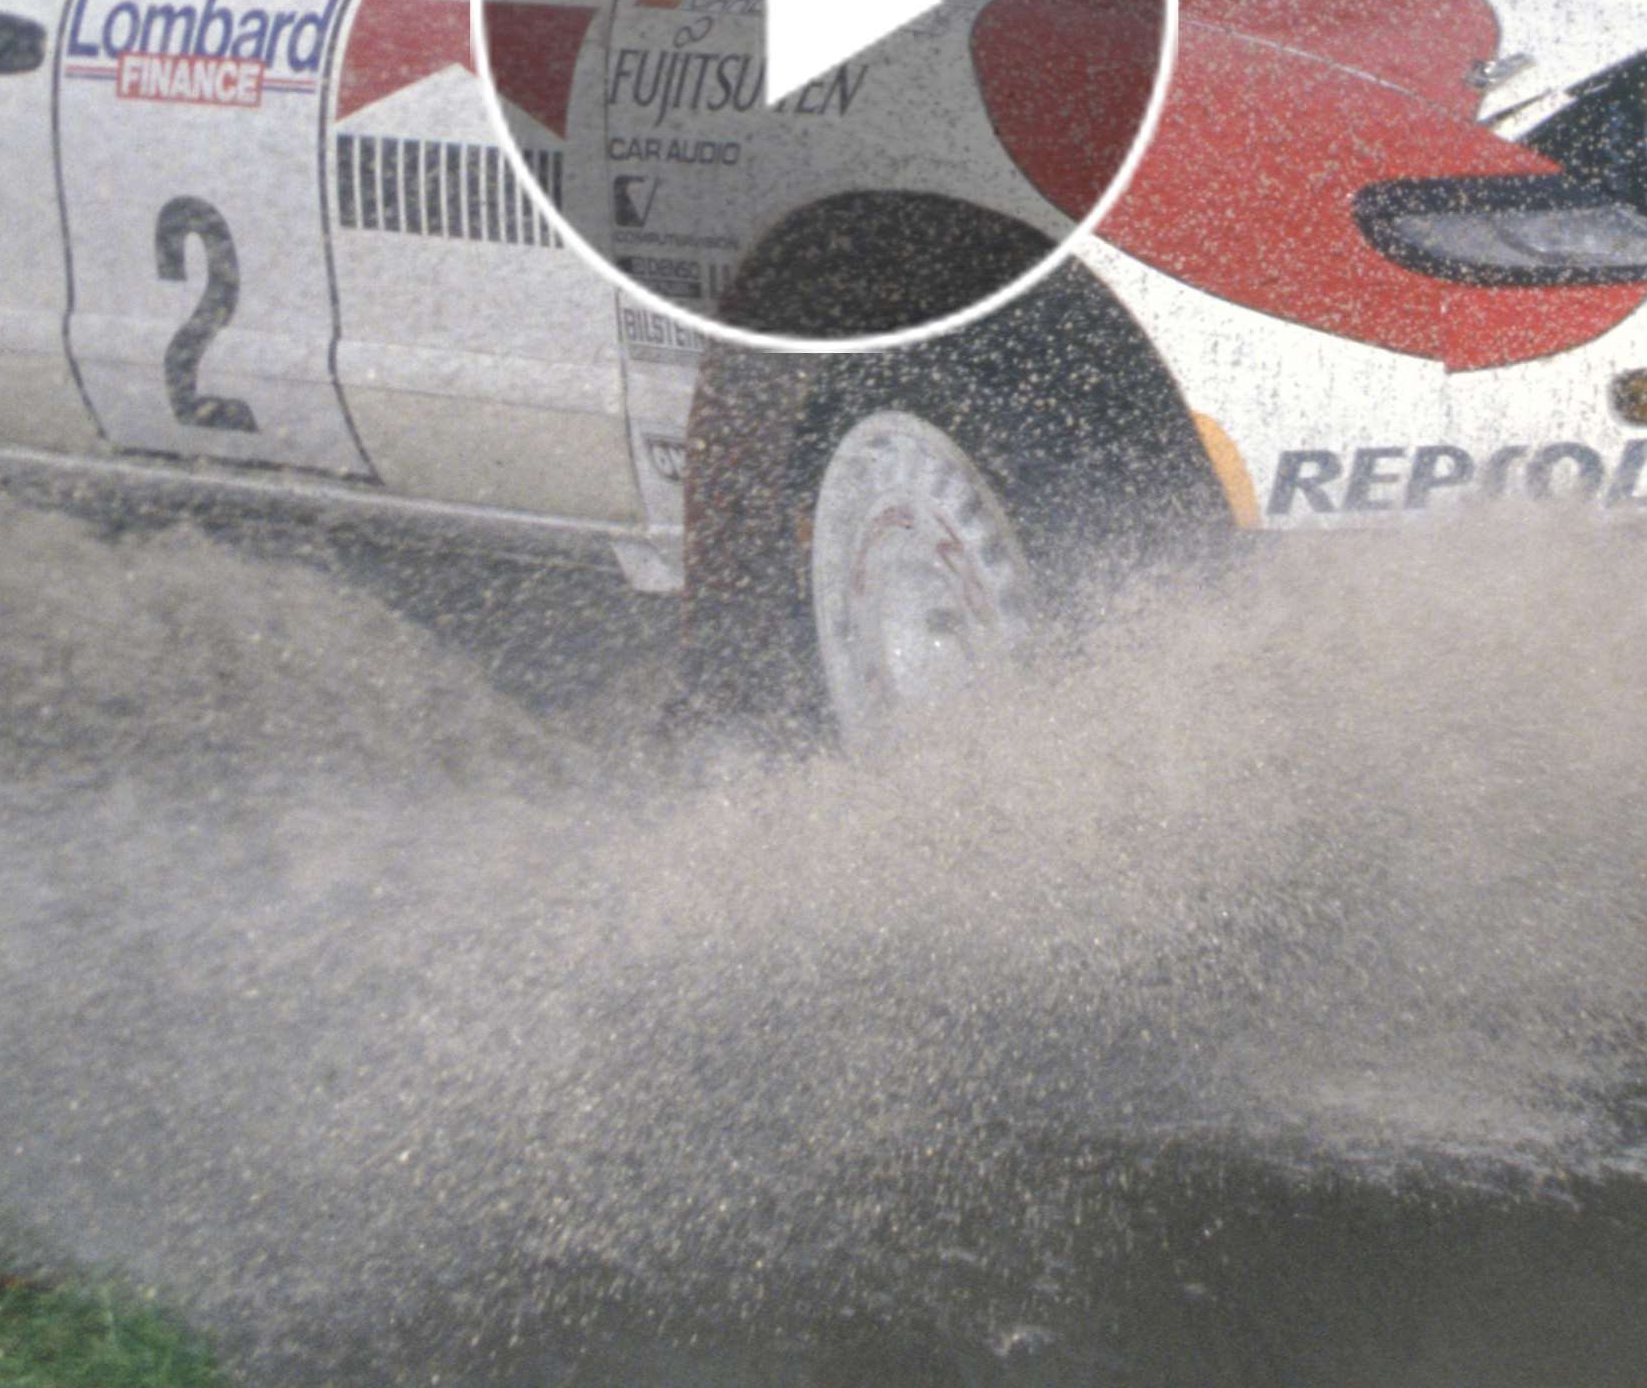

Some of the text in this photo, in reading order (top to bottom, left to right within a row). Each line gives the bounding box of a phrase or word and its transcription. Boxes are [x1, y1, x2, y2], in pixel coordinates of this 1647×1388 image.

[120, 59, 264, 103] FINANCE
[774, 63, 869, 117] EN
[609, 137, 741, 165] CAR AUDIO
[154, 195, 259, 432] 2
